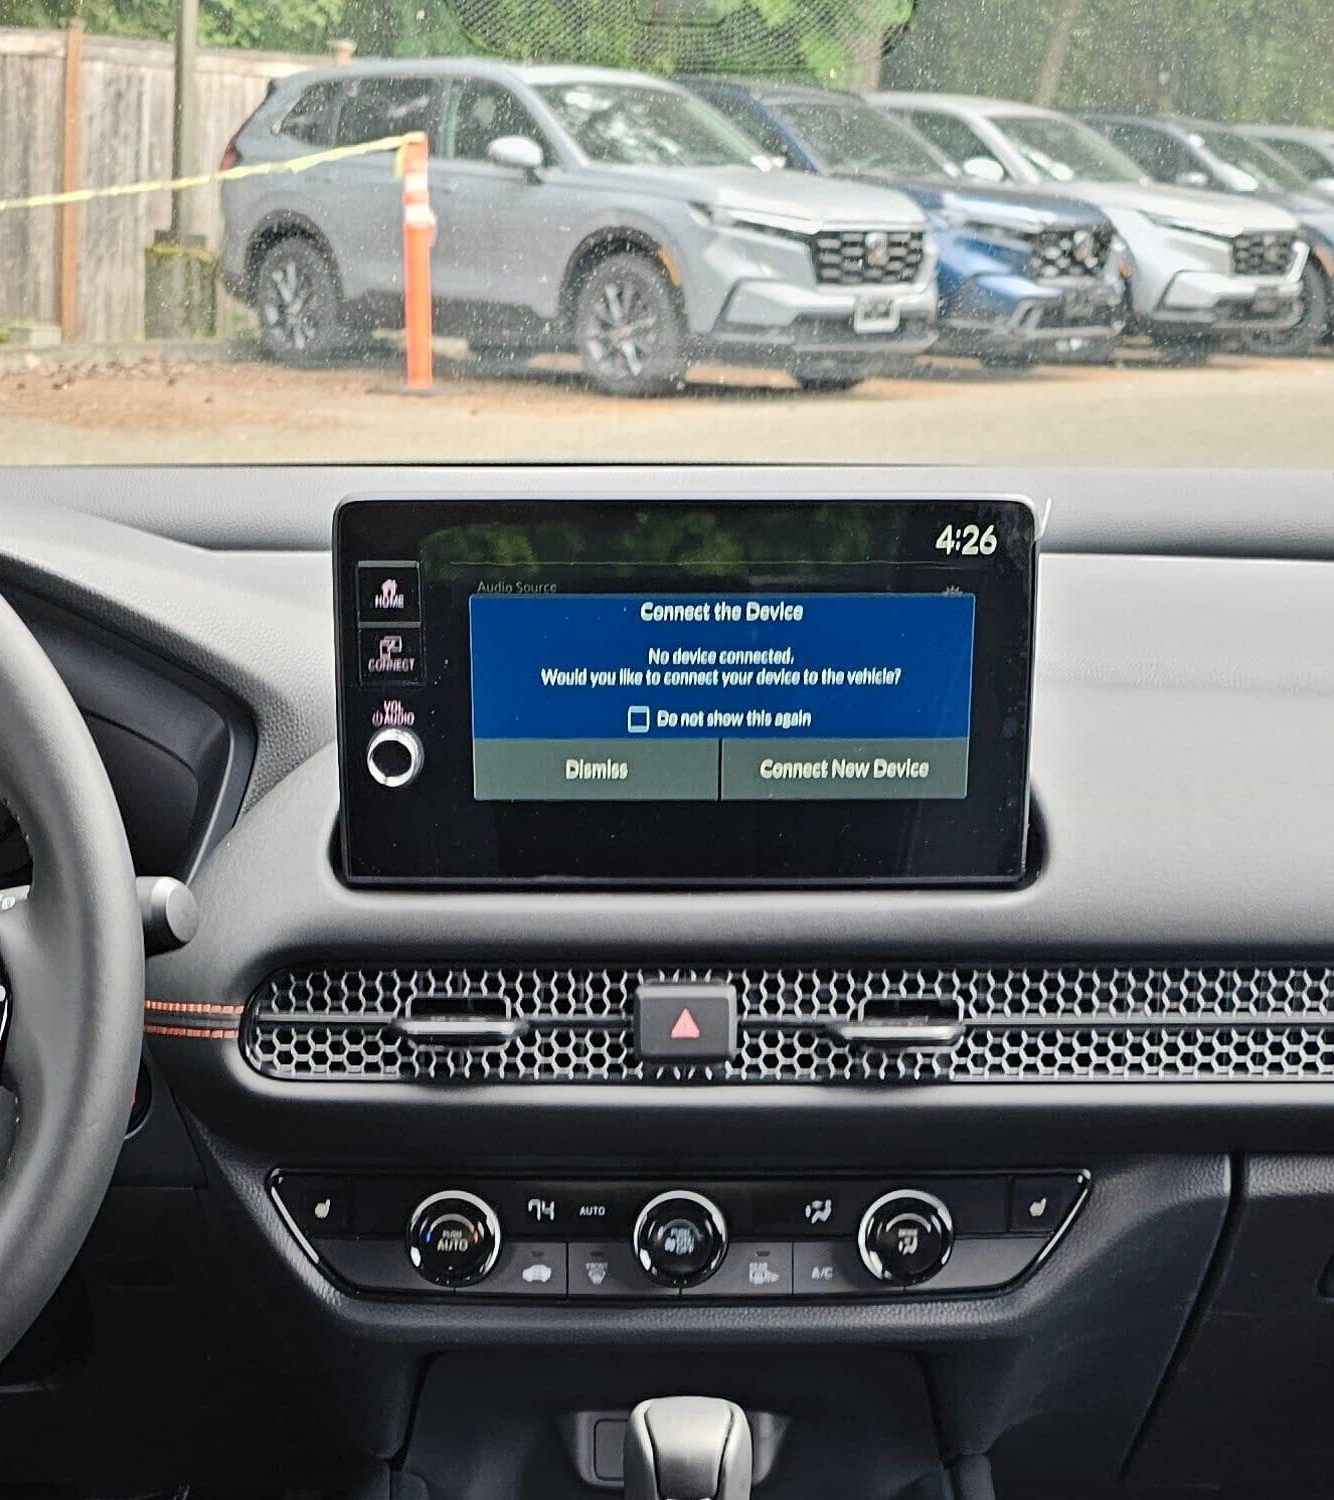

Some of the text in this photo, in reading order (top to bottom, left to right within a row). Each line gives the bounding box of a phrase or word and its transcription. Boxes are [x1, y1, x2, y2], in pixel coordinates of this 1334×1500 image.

[935, 524, 998, 555] 4:26
[477, 581, 557, 593] Audio Source
[374, 594, 404, 608] HOME
[641, 602, 804, 621] Connect the Device
[649, 647, 795, 665] No device connected.
[368, 658, 415, 673] CONNECT
[541, 667, 902, 688] Would you like to connect your device to the vehicle?
[383, 712, 415, 726] AUDIO
[657, 709, 811, 729] Do not show this again
[565, 758, 628, 780] Dismiss
[760, 758, 930, 779] Connect New Device
[527, 1198, 555, 1221] 74
[579, 1206, 606, 1216] AUTO
[437, 1239, 468, 1252] AUTO
[811, 1266, 833, 1280] A/C
